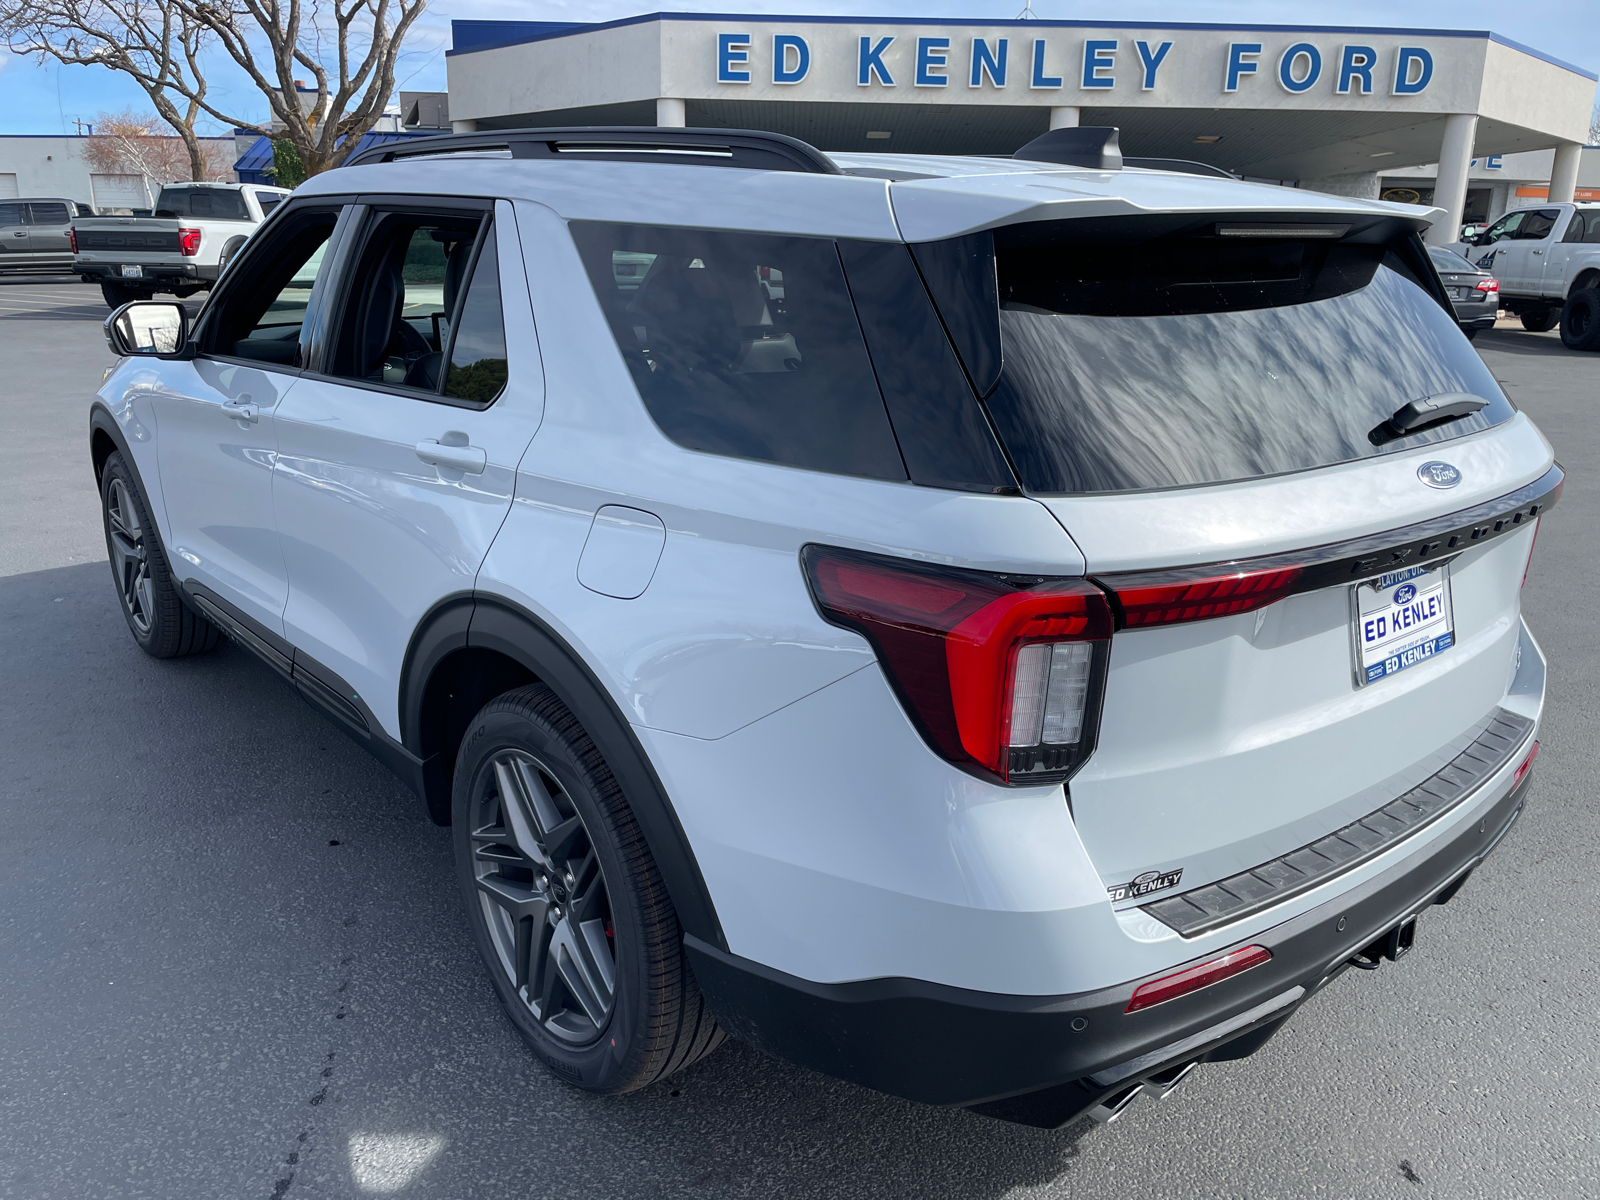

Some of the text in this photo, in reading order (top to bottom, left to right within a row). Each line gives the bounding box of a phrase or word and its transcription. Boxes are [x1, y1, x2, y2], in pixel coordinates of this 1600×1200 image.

[716, 33, 1434, 96] ED KENLEY FORD
[87, 236, 168, 246] FORD
[1429, 464, 1457, 482] Ford
[1350, 502, 1544, 574] EXPLORER
[1397, 586, 1413, 604] Ford
[1364, 592, 1446, 643] ED KENLEY
[1385, 656, 1399, 675] ED
[1401, 639, 1437, 668] KENLEY
[1109, 872, 1182, 901] ED KENLEY
